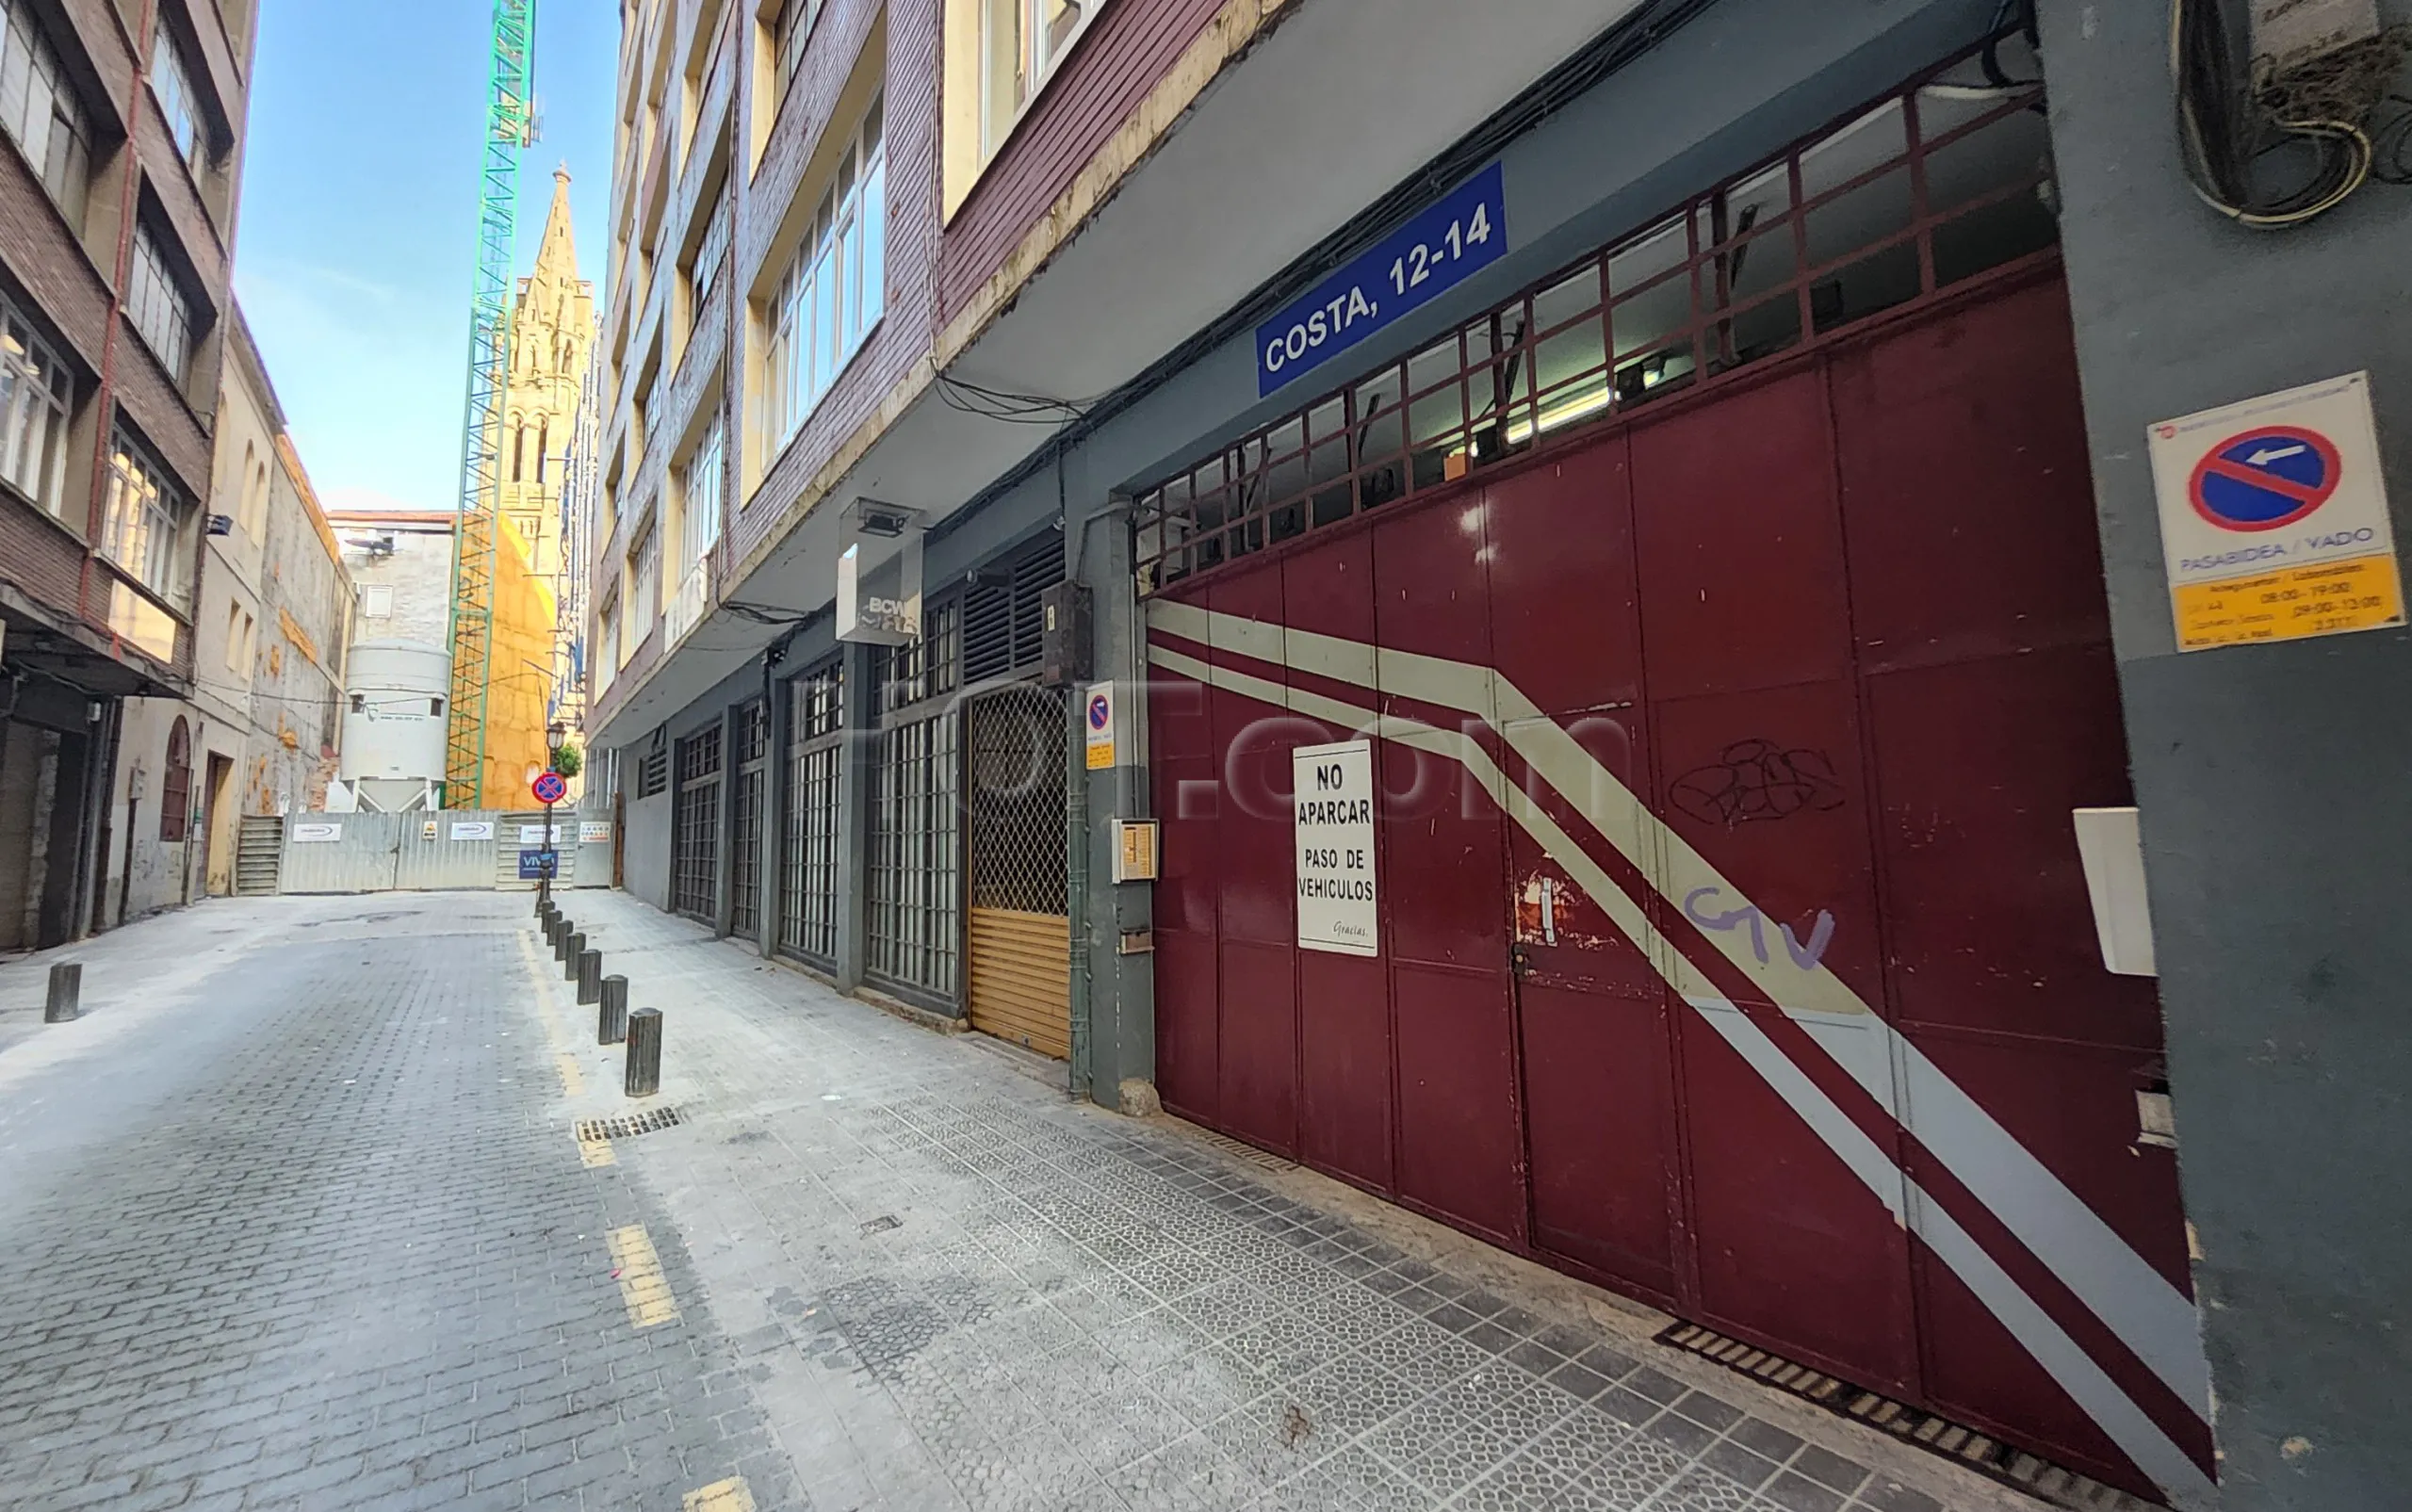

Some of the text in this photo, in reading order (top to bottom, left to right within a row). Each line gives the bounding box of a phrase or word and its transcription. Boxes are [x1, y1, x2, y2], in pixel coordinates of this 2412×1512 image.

[1265, 203, 1491, 372] COSTA, 12-14
[2305, 528, 2373, 549] VADO
[1316, 764, 1344, 791] NO
[1297, 799, 1371, 826] APARCAR
[1305, 849, 1364, 870] PASO DE
[1298, 878, 1373, 902] VEHICULOS
